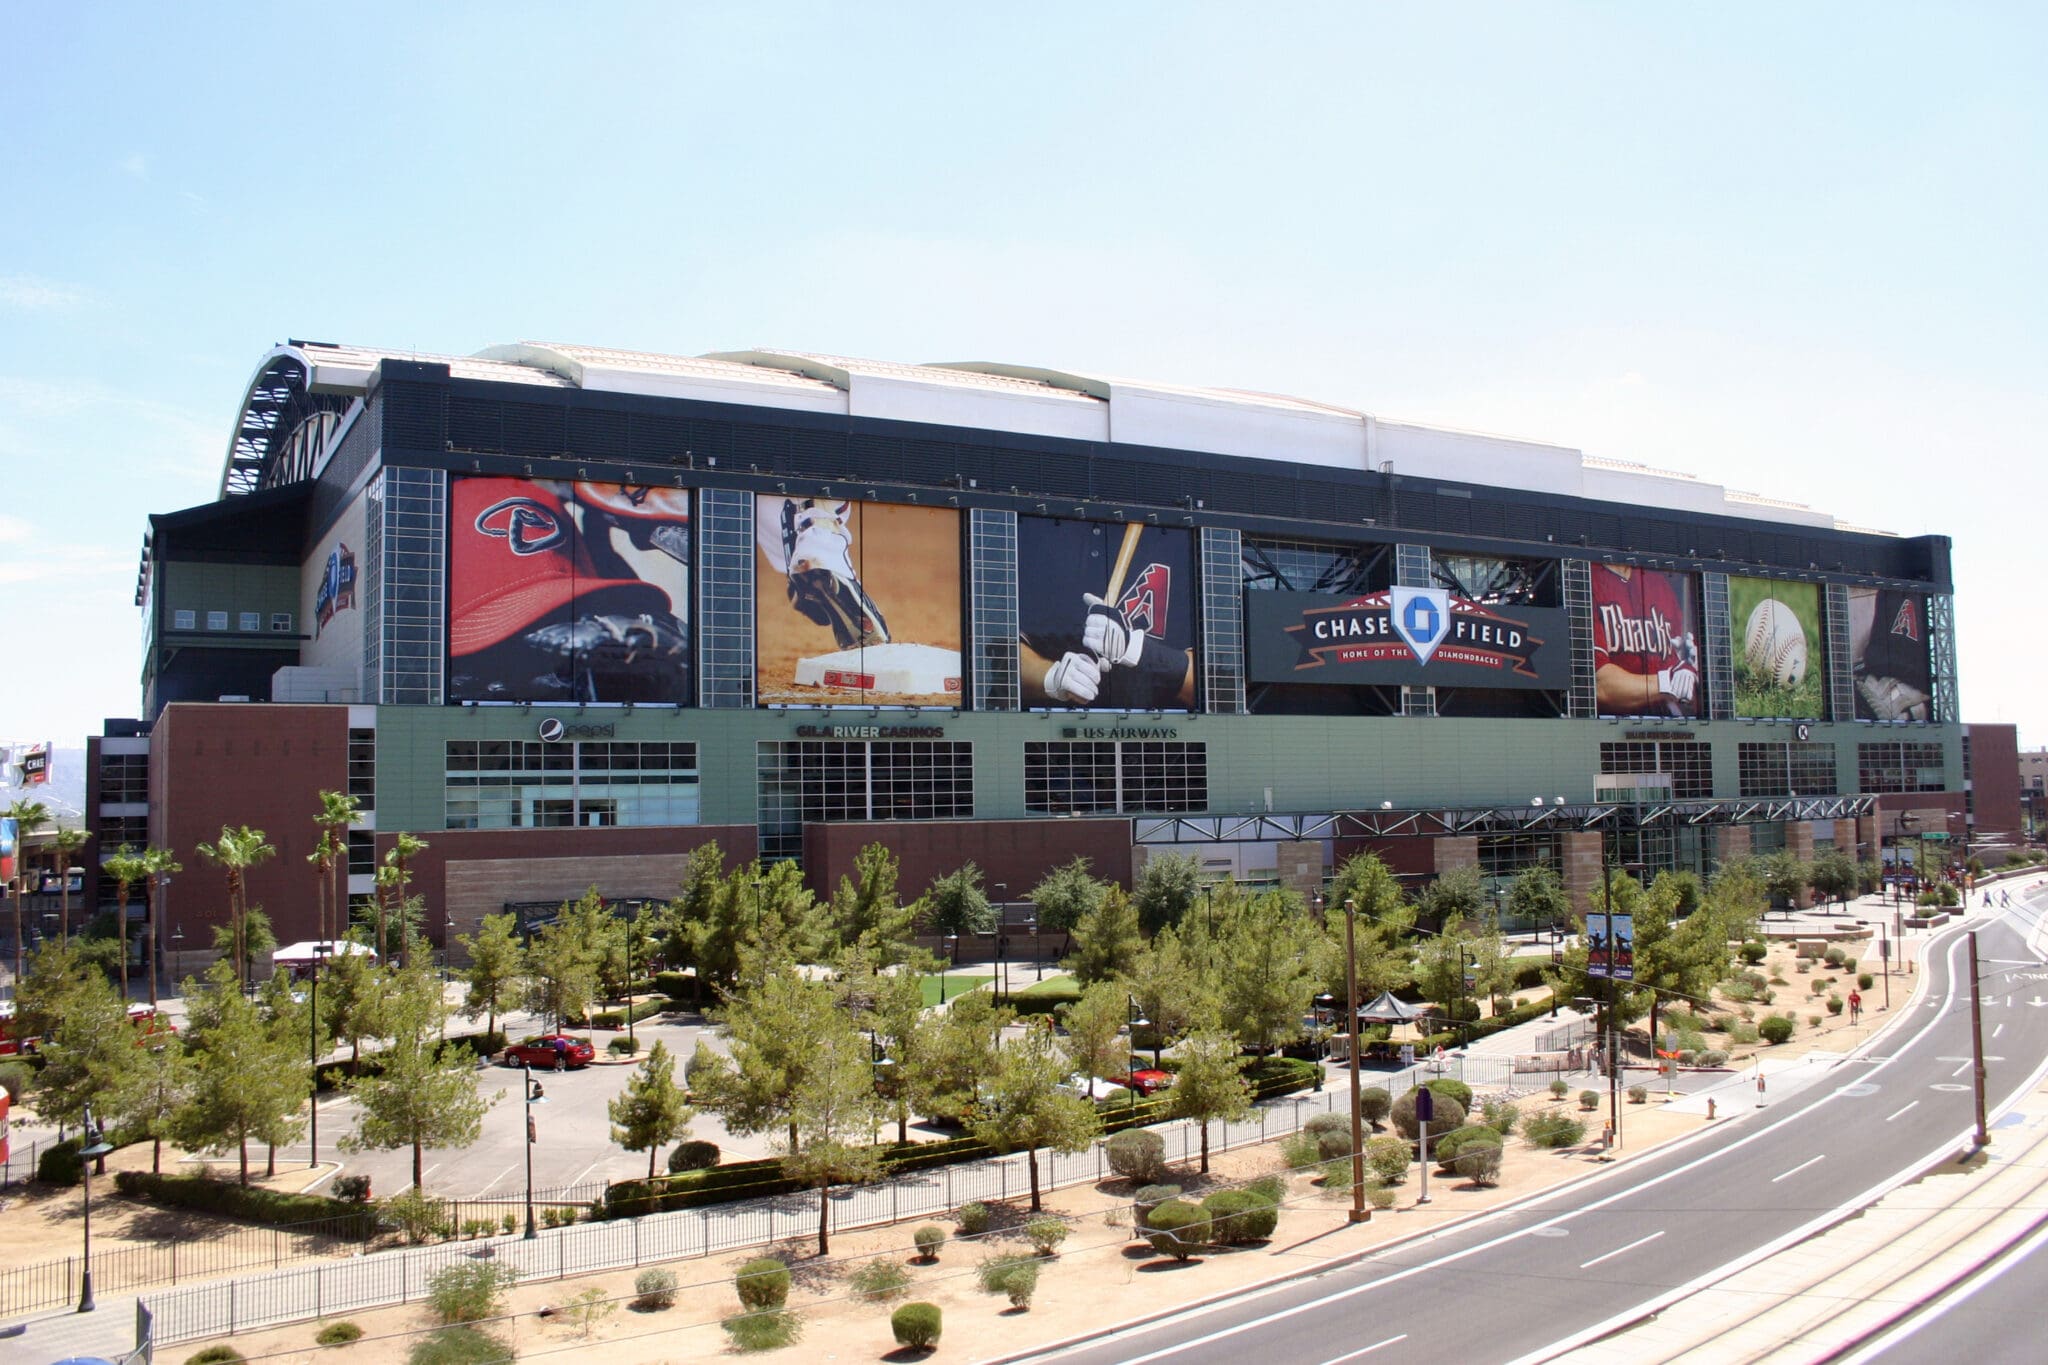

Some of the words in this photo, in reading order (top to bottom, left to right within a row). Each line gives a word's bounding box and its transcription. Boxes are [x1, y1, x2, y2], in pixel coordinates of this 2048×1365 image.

[1314, 616, 1389, 639] CHASE
[1456, 621, 1522, 648] FIELD
[1342, 649, 1368, 659] HOME
[1374, 649, 1385, 657] OF
[1392, 648, 1408, 657] THE
[1438, 651, 1499, 665] DIAMONDBACKS
[833, 726, 880, 738] RIVER
[1109, 727, 1177, 739] AIRWAYS
